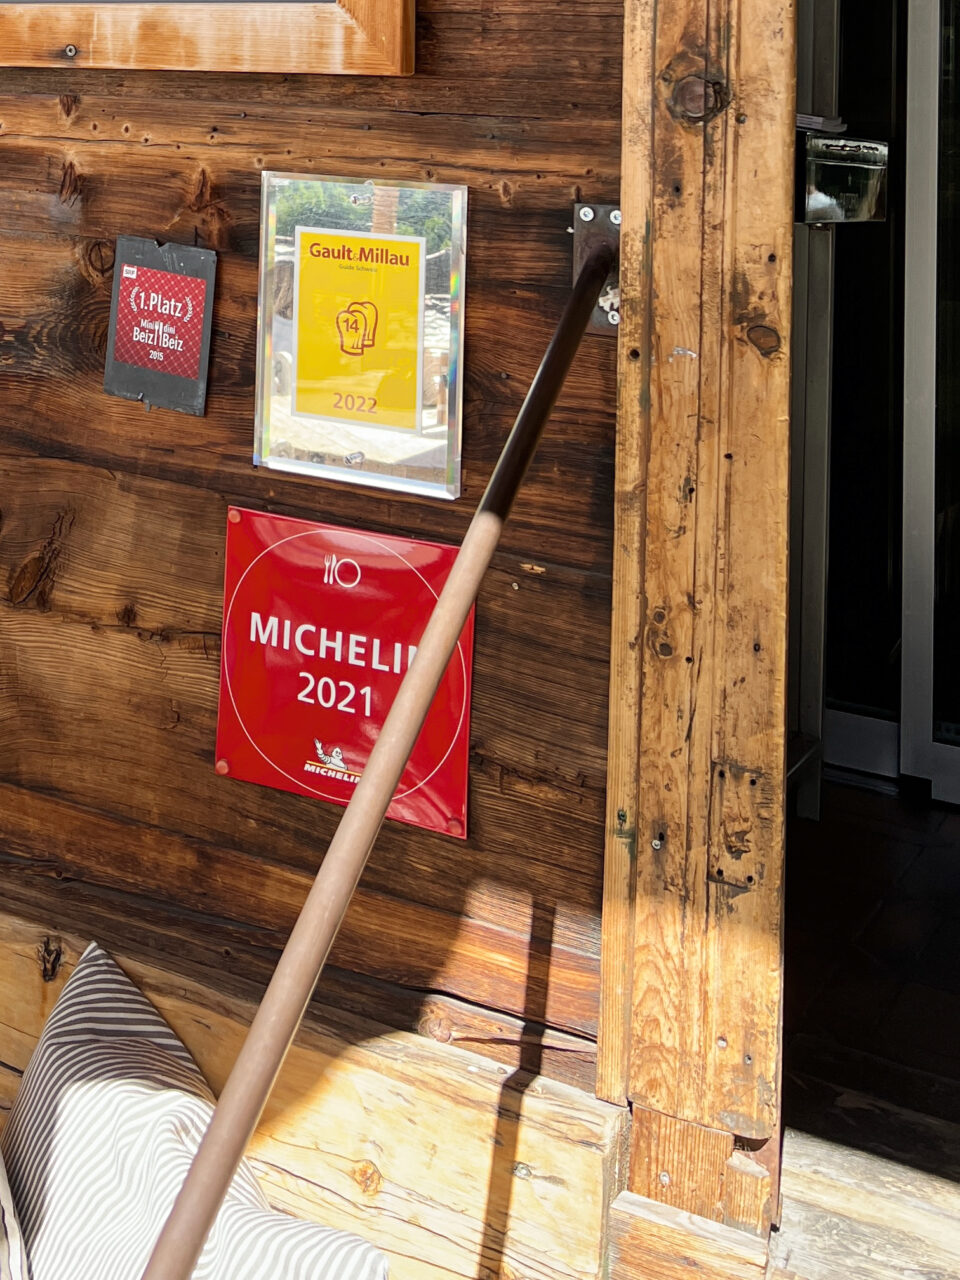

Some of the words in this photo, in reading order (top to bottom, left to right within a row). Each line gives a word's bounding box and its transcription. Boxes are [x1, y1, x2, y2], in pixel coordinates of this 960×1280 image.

[140, 318, 154, 330] Mini
[343, 318, 360, 333] 14
[133, 326, 154, 345] Beiz
[162, 333, 184, 352] Beiz
[149, 349, 164, 361] 2015
[333, 392, 378, 414] 2022
[297, 671, 372, 717] 2021
